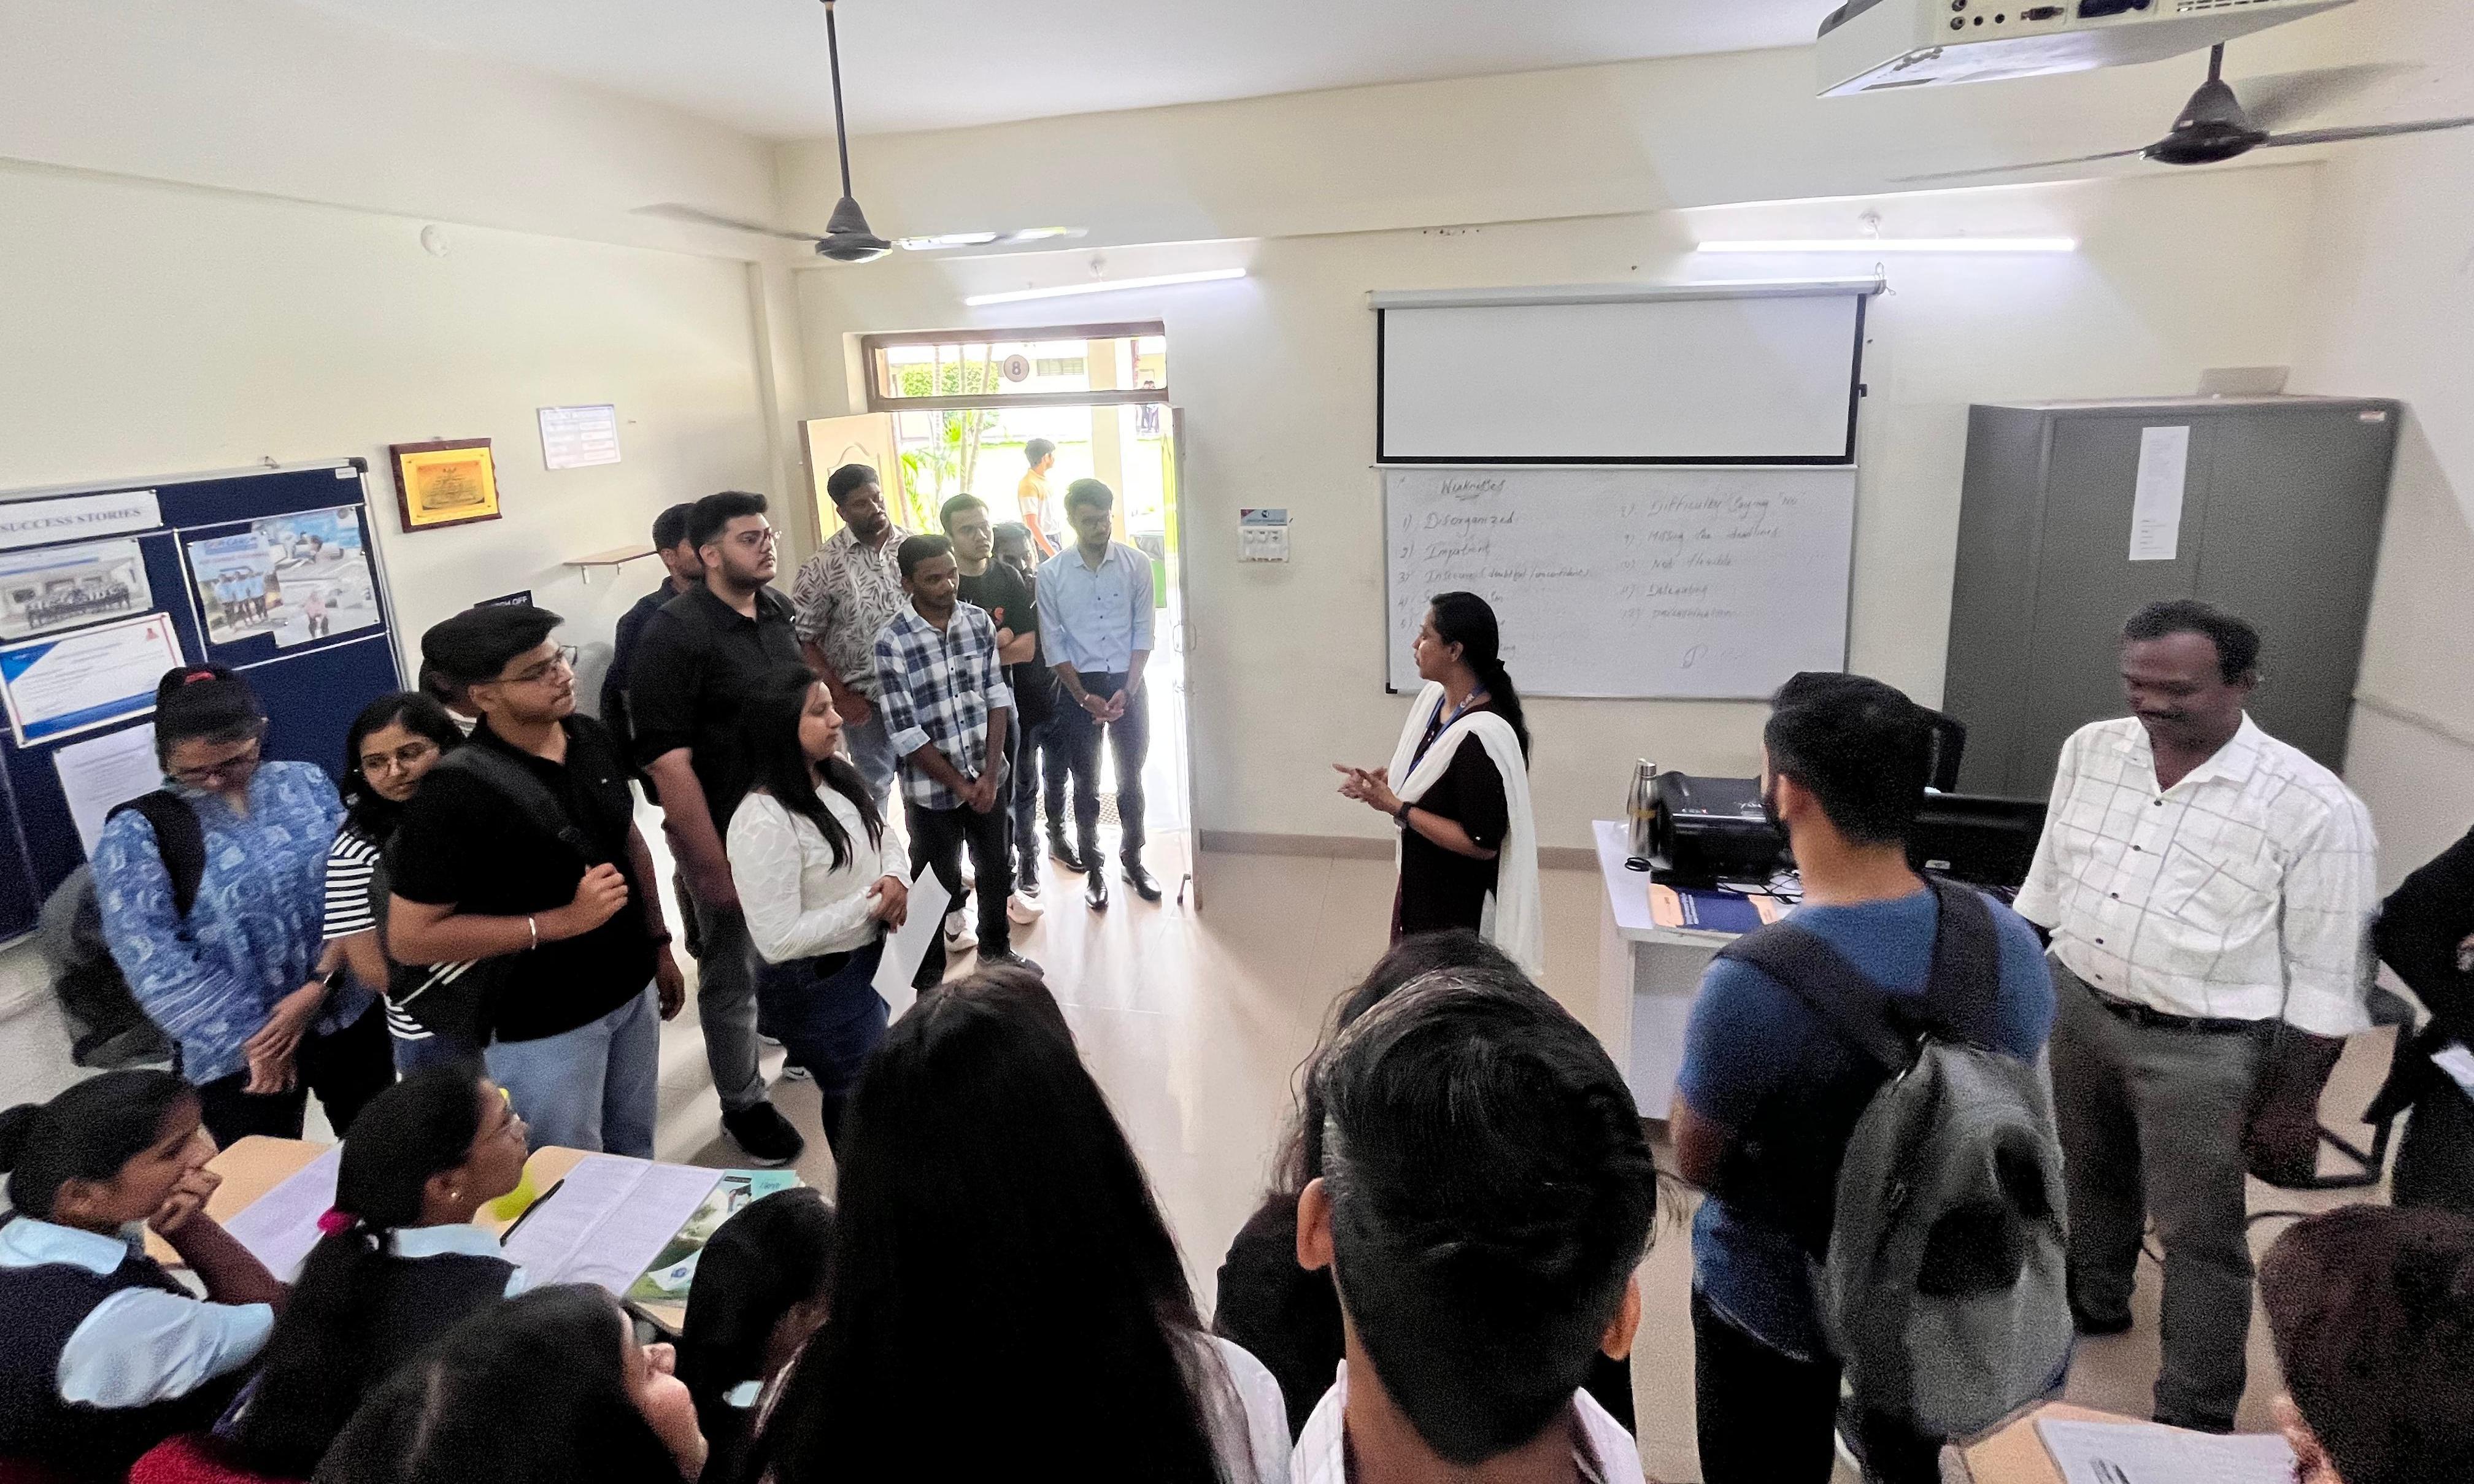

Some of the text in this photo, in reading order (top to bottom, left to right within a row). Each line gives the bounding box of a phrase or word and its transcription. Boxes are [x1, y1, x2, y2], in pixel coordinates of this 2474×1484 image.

[1012, 361, 1021, 375] 8
[1, 507, 142, 532] SUCCESS STORIES
[1424, 510, 1514, 537] Disorganized
[1423, 542, 1490, 564] Impatient
